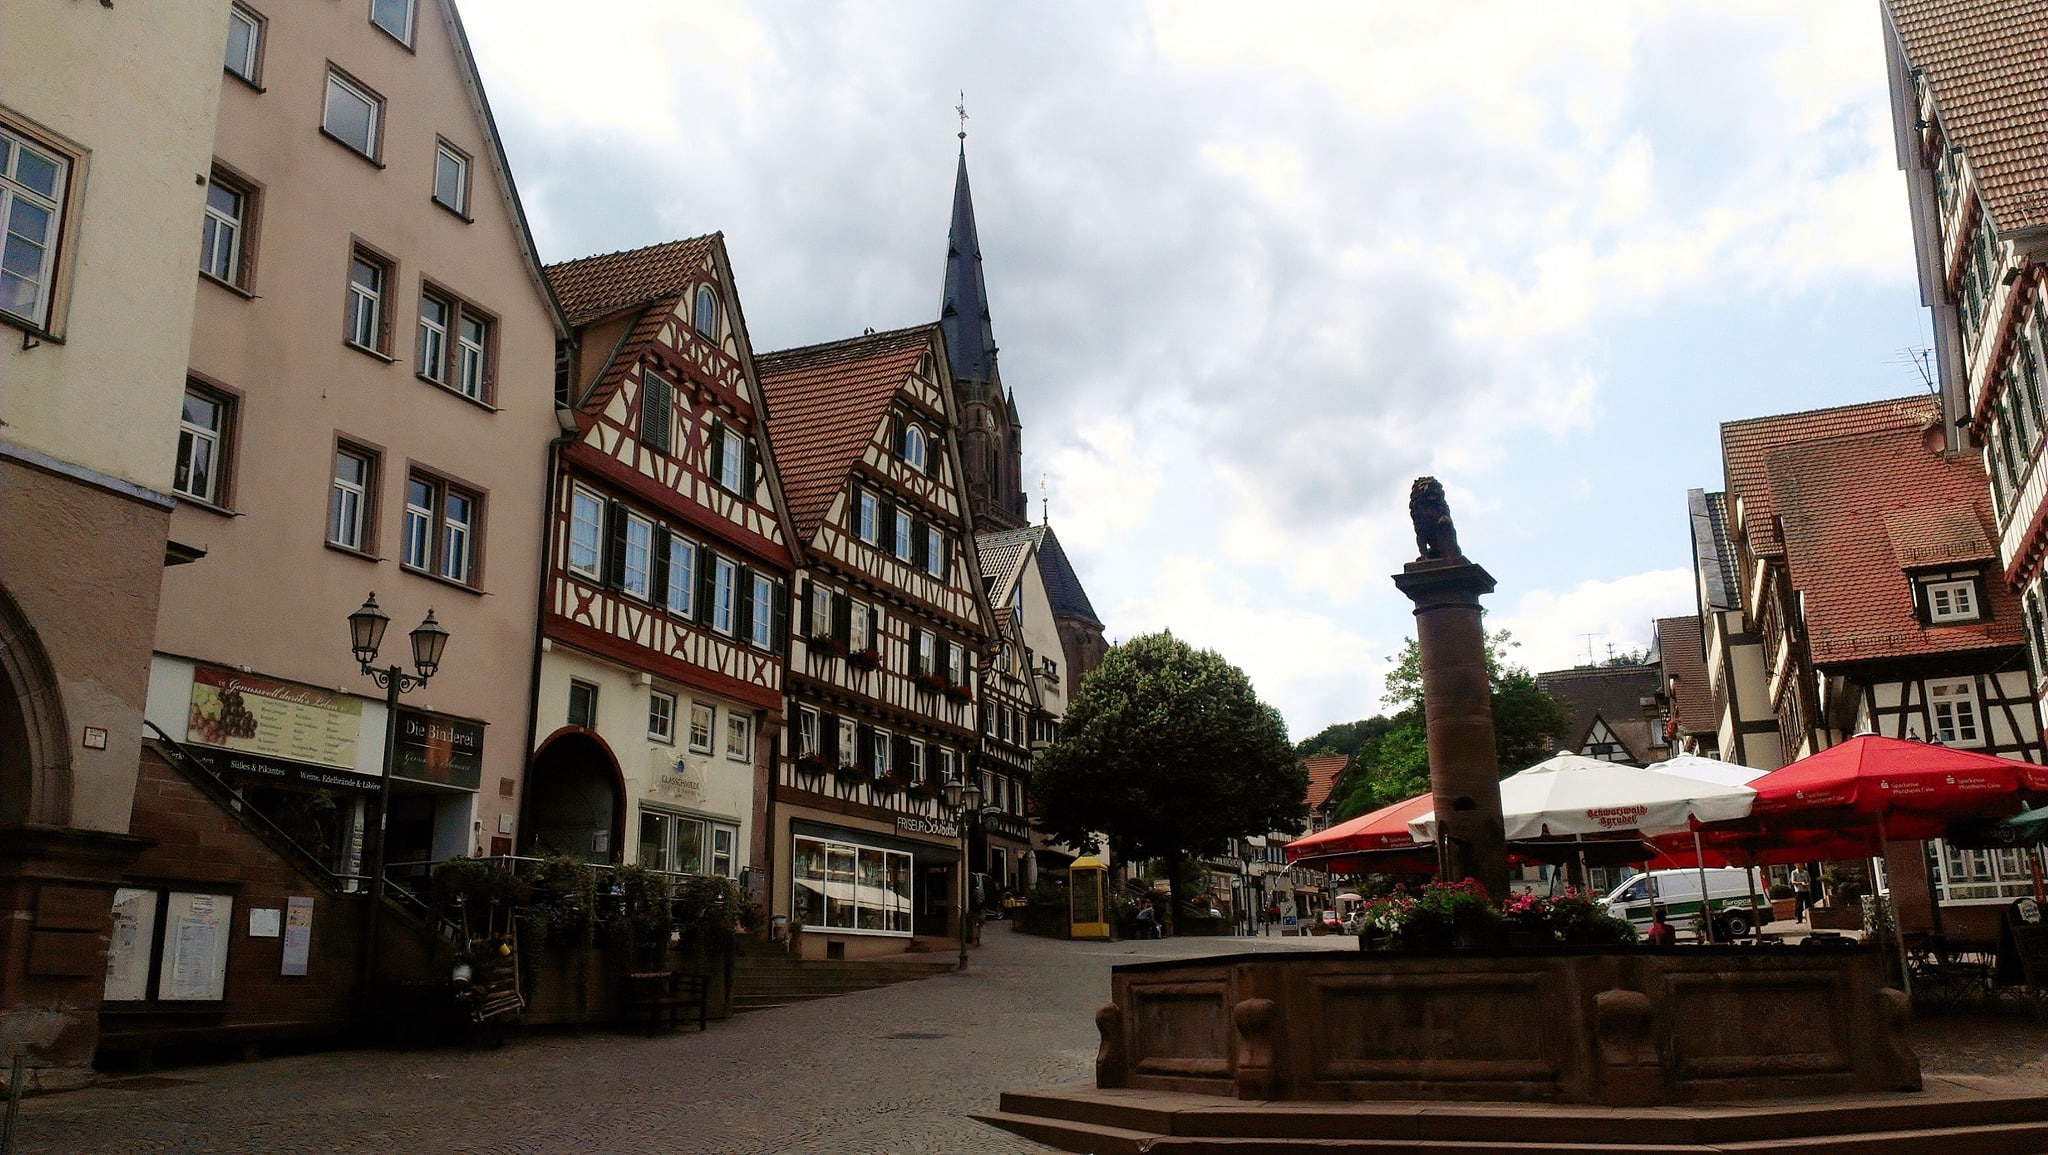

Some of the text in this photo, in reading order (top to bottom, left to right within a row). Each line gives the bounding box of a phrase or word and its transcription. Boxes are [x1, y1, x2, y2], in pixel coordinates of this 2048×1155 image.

[405, 719, 474, 747] Die Binderei
[230, 759, 250, 772] Süßes
[251, 763, 257, 773] &
[257, 764, 286, 777] Pikantes
[321, 774, 355, 788] Edelbrände
[362, 780, 381, 791] Liköre
[1586, 805, 1648, 820] Schwarzwald
[896, 816, 925, 833] FRISEUR
[1599, 815, 1638, 829] Sprudel
[1722, 898, 1753, 907] Europca
